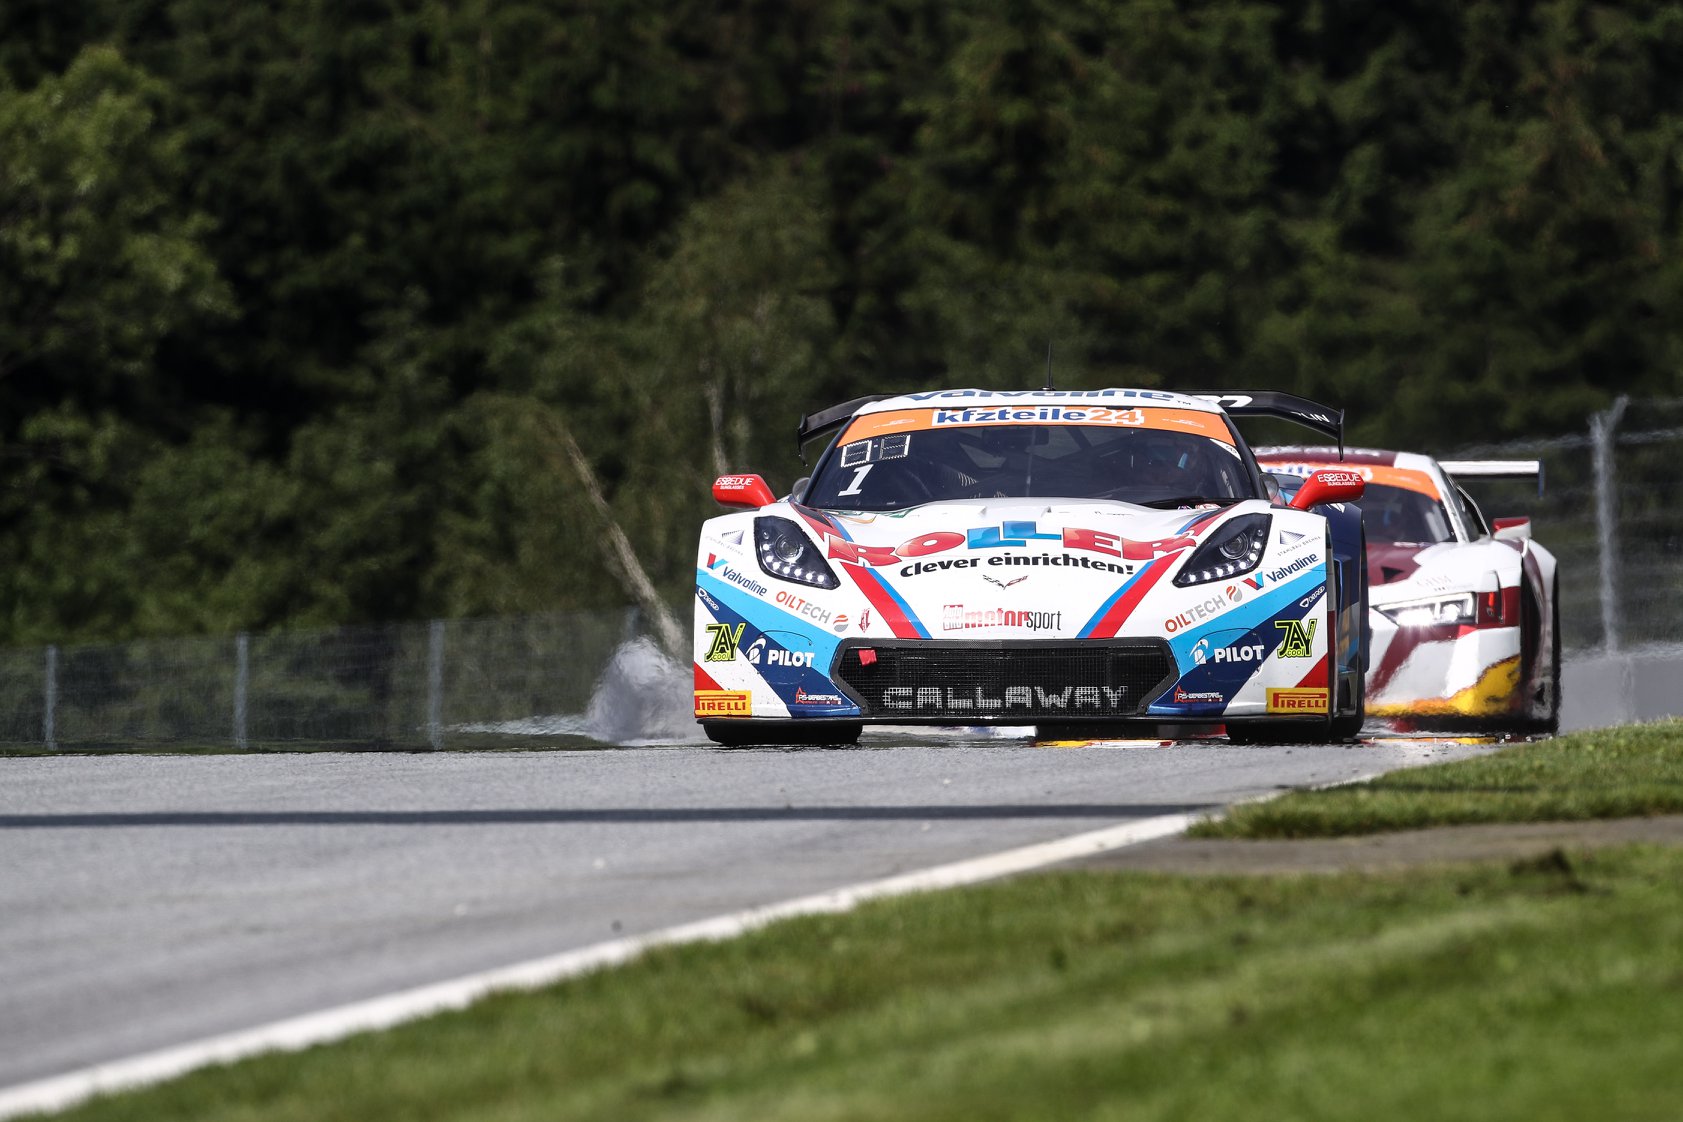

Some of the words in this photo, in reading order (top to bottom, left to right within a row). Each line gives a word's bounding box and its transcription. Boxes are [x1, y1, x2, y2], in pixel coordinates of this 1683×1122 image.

[937, 408, 1140, 424] kfzteile24
[838, 464, 874, 496] 1
[1317, 473, 1361, 483] ESSEDUE
[828, 520, 1197, 567] ROLLER
[900, 557, 981, 577] clever
[987, 552, 1134, 575] einrichten!
[1266, 553, 1319, 582] Valvoline
[722, 565, 768, 597] Valvoline
[776, 591, 831, 624] OILTECH
[1164, 594, 1226, 633] OILTECH
[705, 622, 746, 662] JAY
[1274, 618, 1317, 658] JAY
[767, 649, 815, 668] PILOT
[1214, 644, 1265, 663] PILOT
[695, 694, 746, 711] PIRELLI
[882, 685, 1128, 709] CALLAWAY
[1273, 692, 1327, 708] PIRELLI
